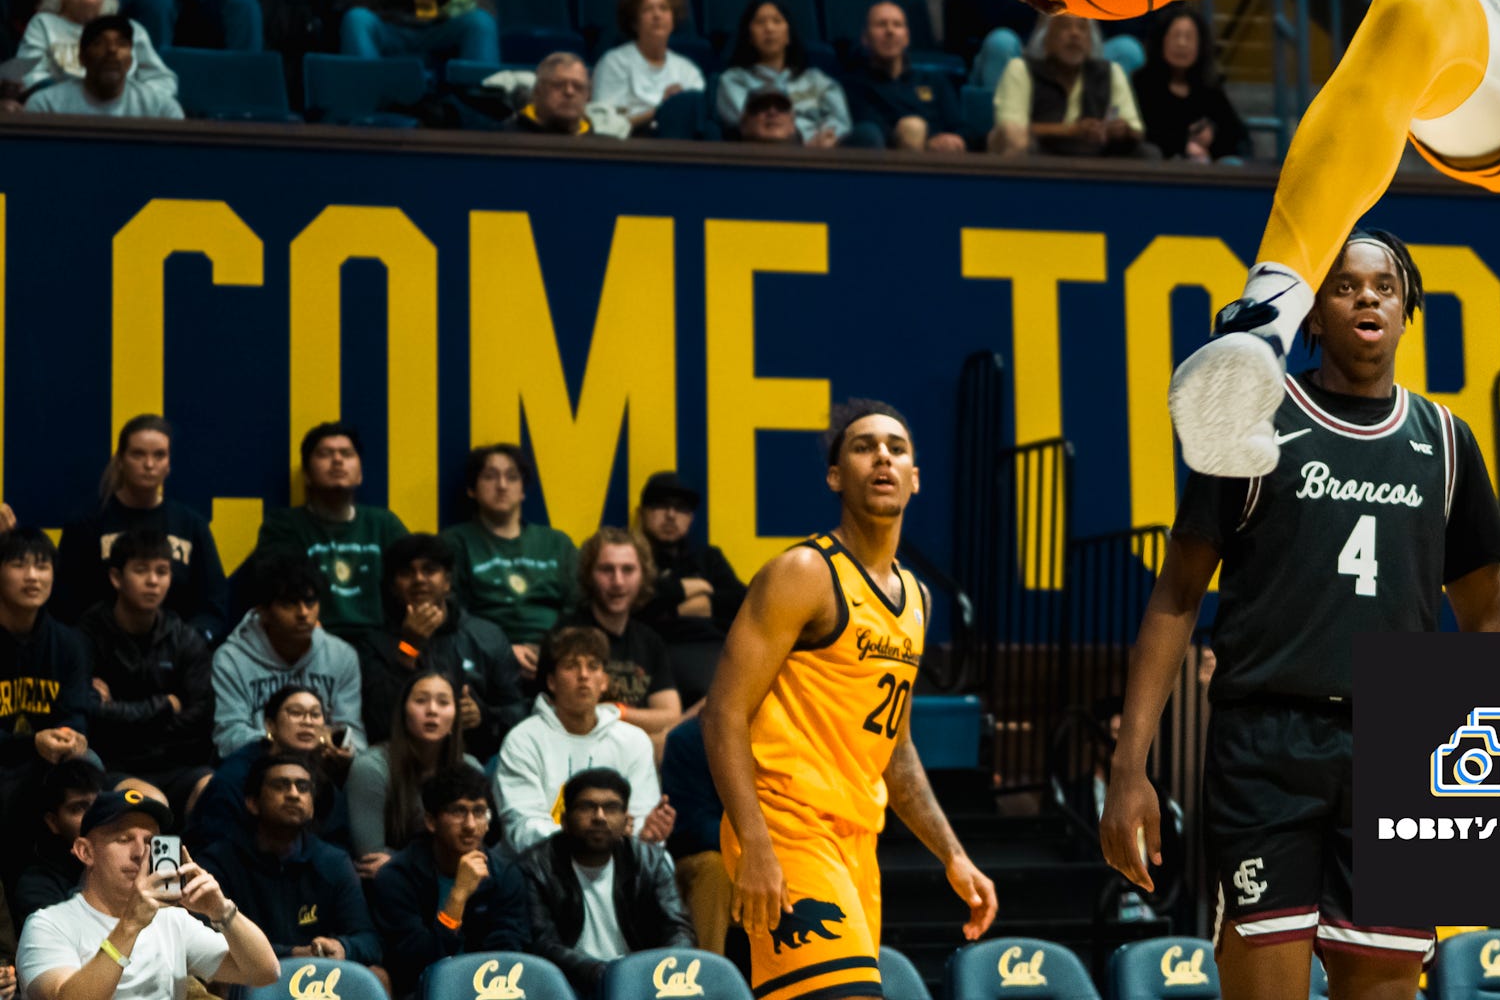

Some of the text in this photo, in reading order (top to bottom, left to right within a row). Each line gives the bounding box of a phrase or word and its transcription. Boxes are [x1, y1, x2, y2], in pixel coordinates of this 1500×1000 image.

[0, 190, 832, 592] COME
[1296, 461, 1424, 508] Broncos
[1337, 514, 1379, 597] 4
[856, 628, 900, 662] Golden
[862, 672, 911, 741] 20
[289, 964, 342, 1000] Cal
[473, 959, 526, 1000] Cal
[652, 956, 704, 998] Cal
[997, 945, 1048, 987] Cal
[1160, 945, 1210, 987] Cal
